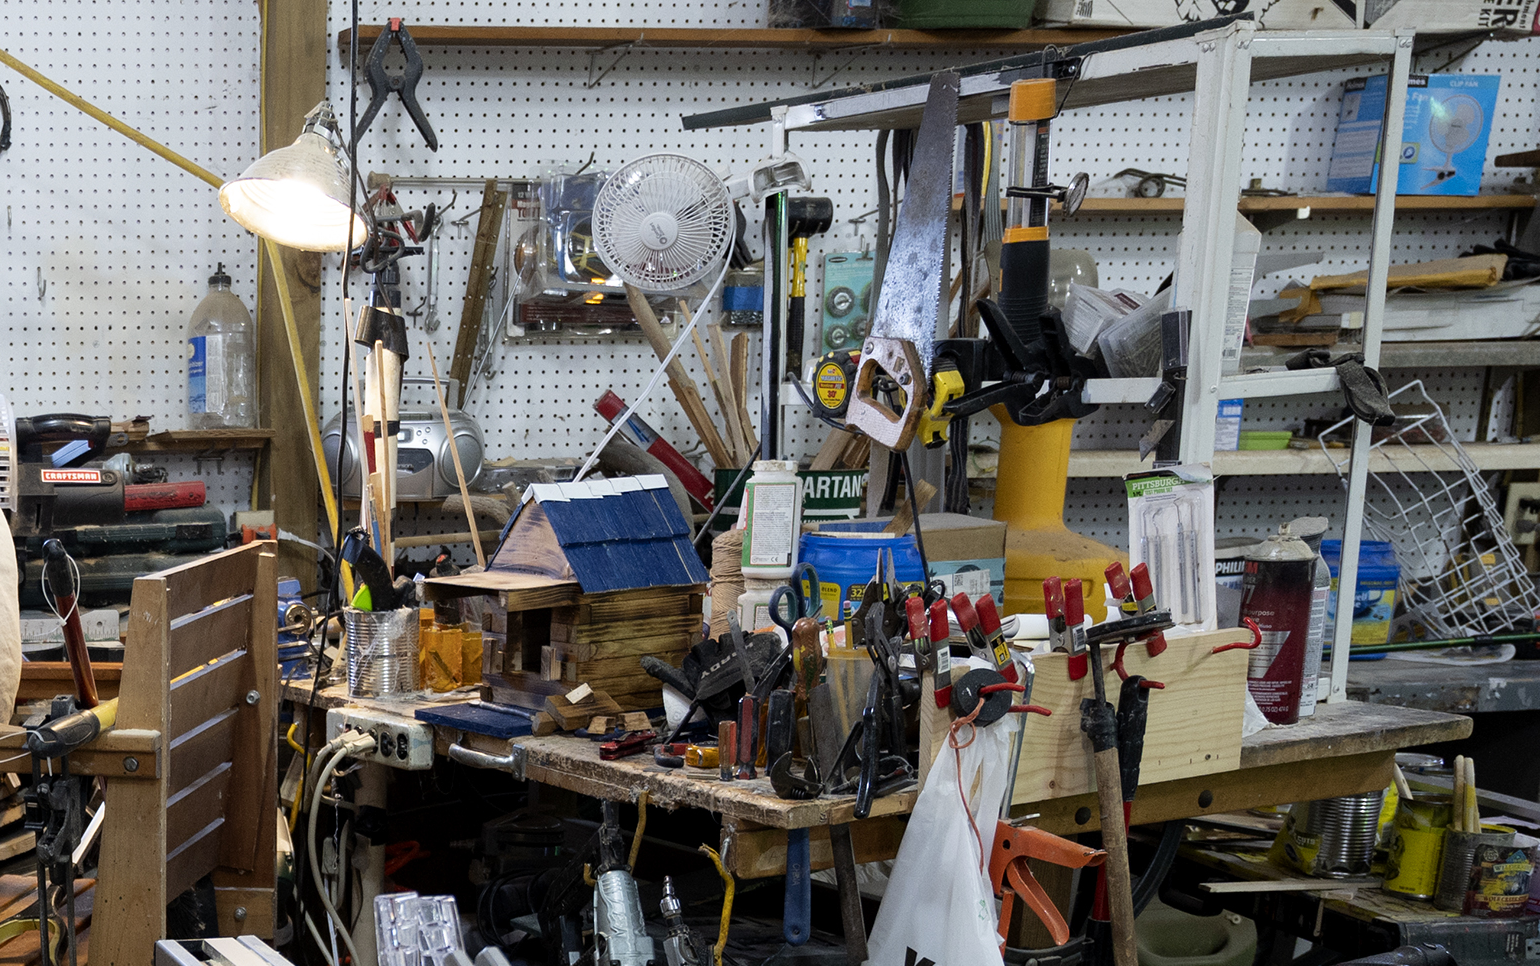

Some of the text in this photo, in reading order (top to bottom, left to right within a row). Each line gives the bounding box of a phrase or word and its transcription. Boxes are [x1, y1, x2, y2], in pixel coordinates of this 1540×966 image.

[1478, 9, 1491, 27] KIT
[45, 472, 97, 480] CRAFTSMAN
[802, 475, 863, 499] ARTAN
[1244, 562, 1258, 574] M
